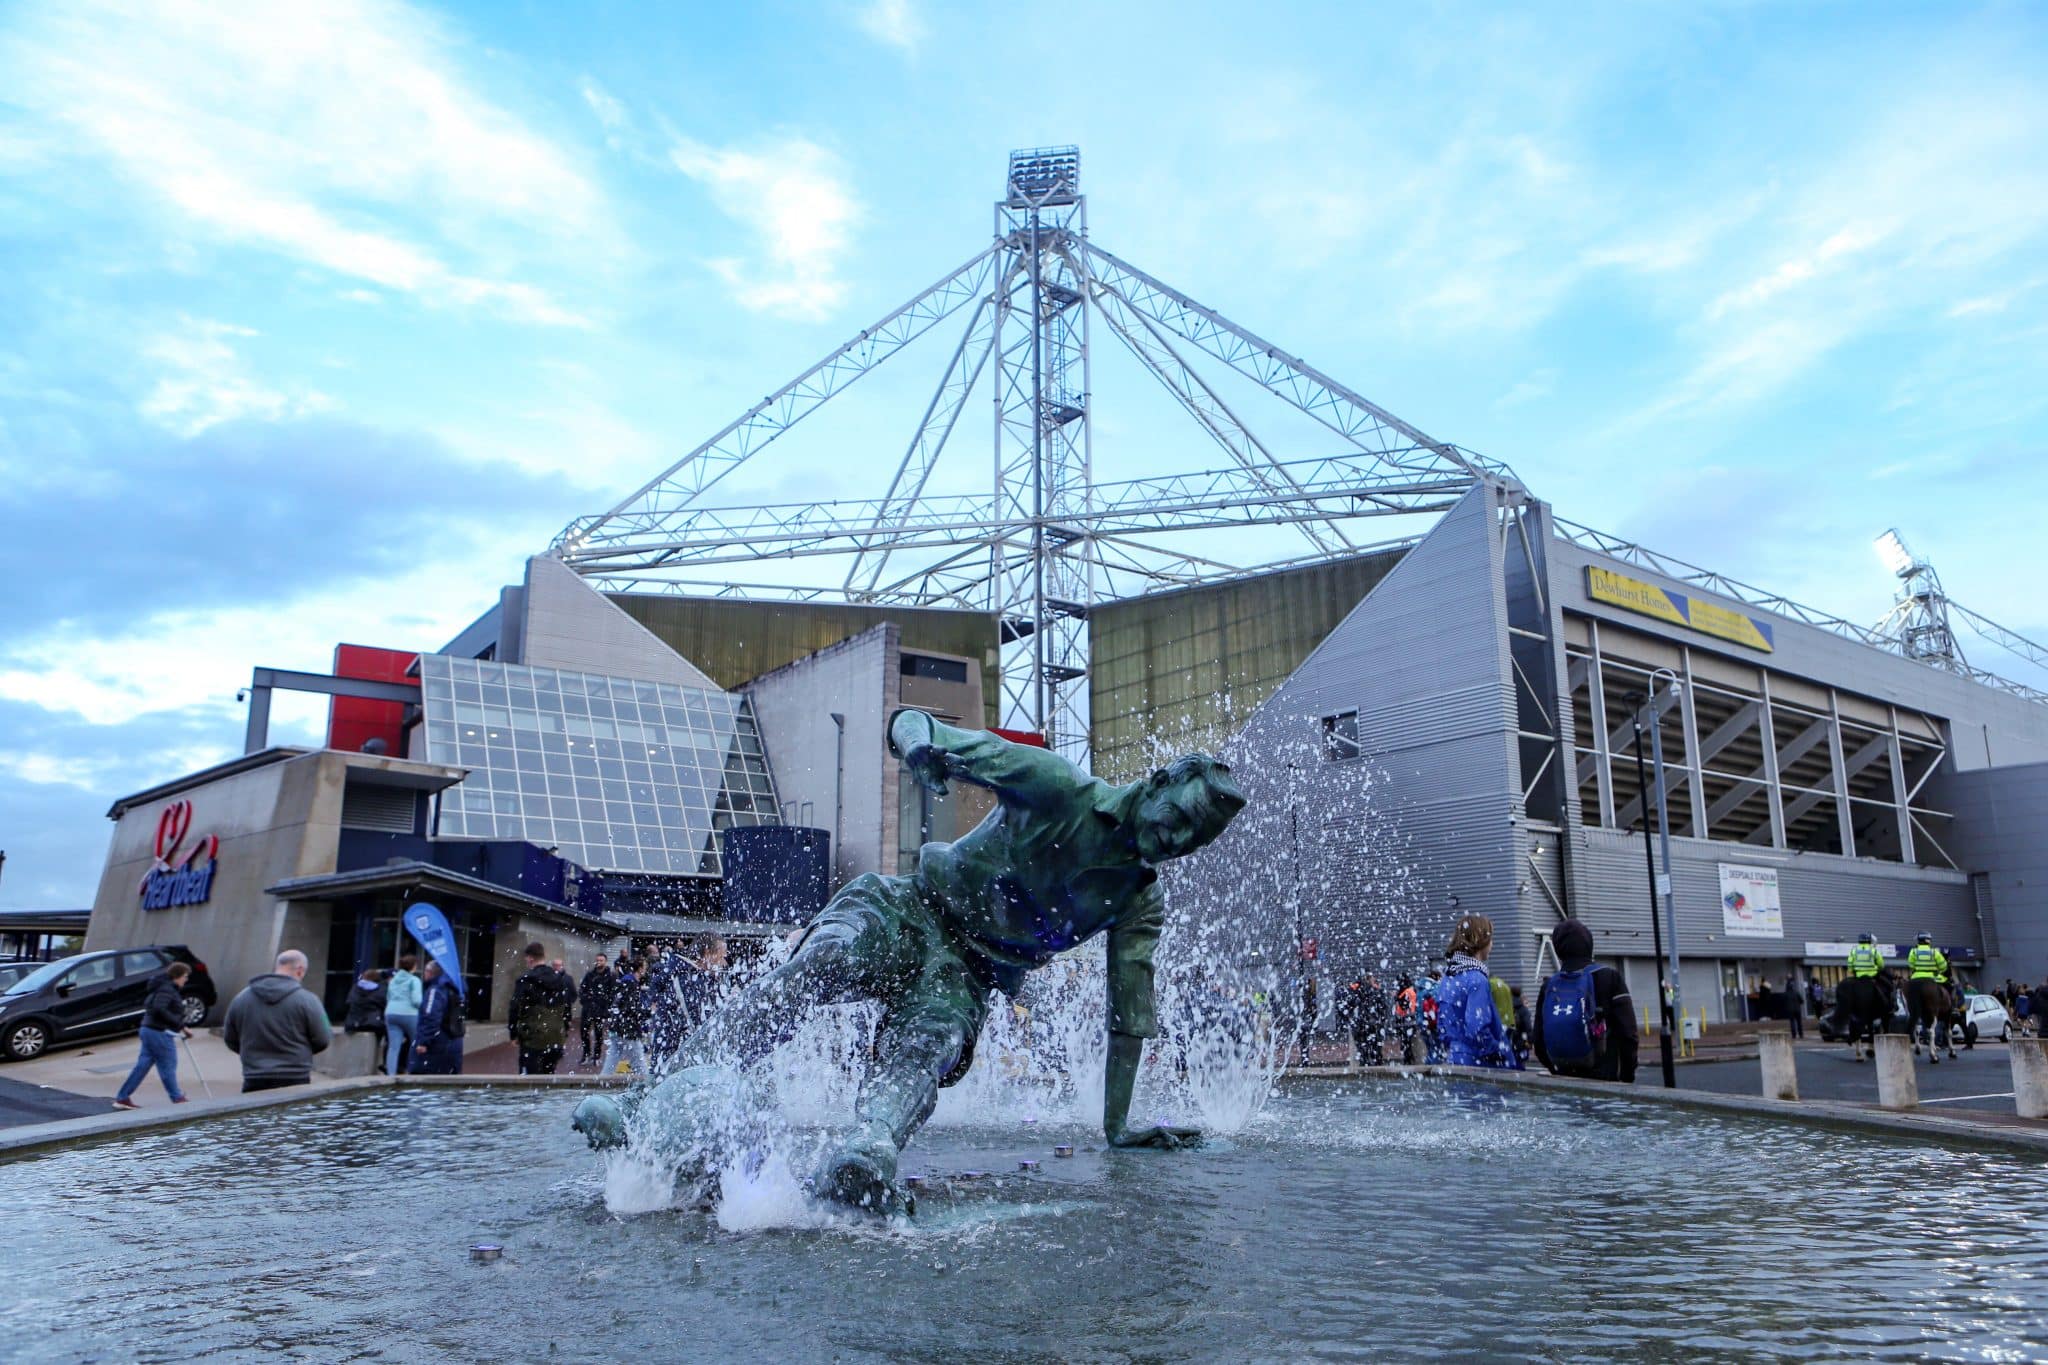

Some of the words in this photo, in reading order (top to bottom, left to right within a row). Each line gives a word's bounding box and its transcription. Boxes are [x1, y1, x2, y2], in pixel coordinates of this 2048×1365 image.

[1595, 575, 1638, 601] Dewhurst
[1641, 590, 1671, 612] Homes
[143, 859, 217, 911] Heartbeat
